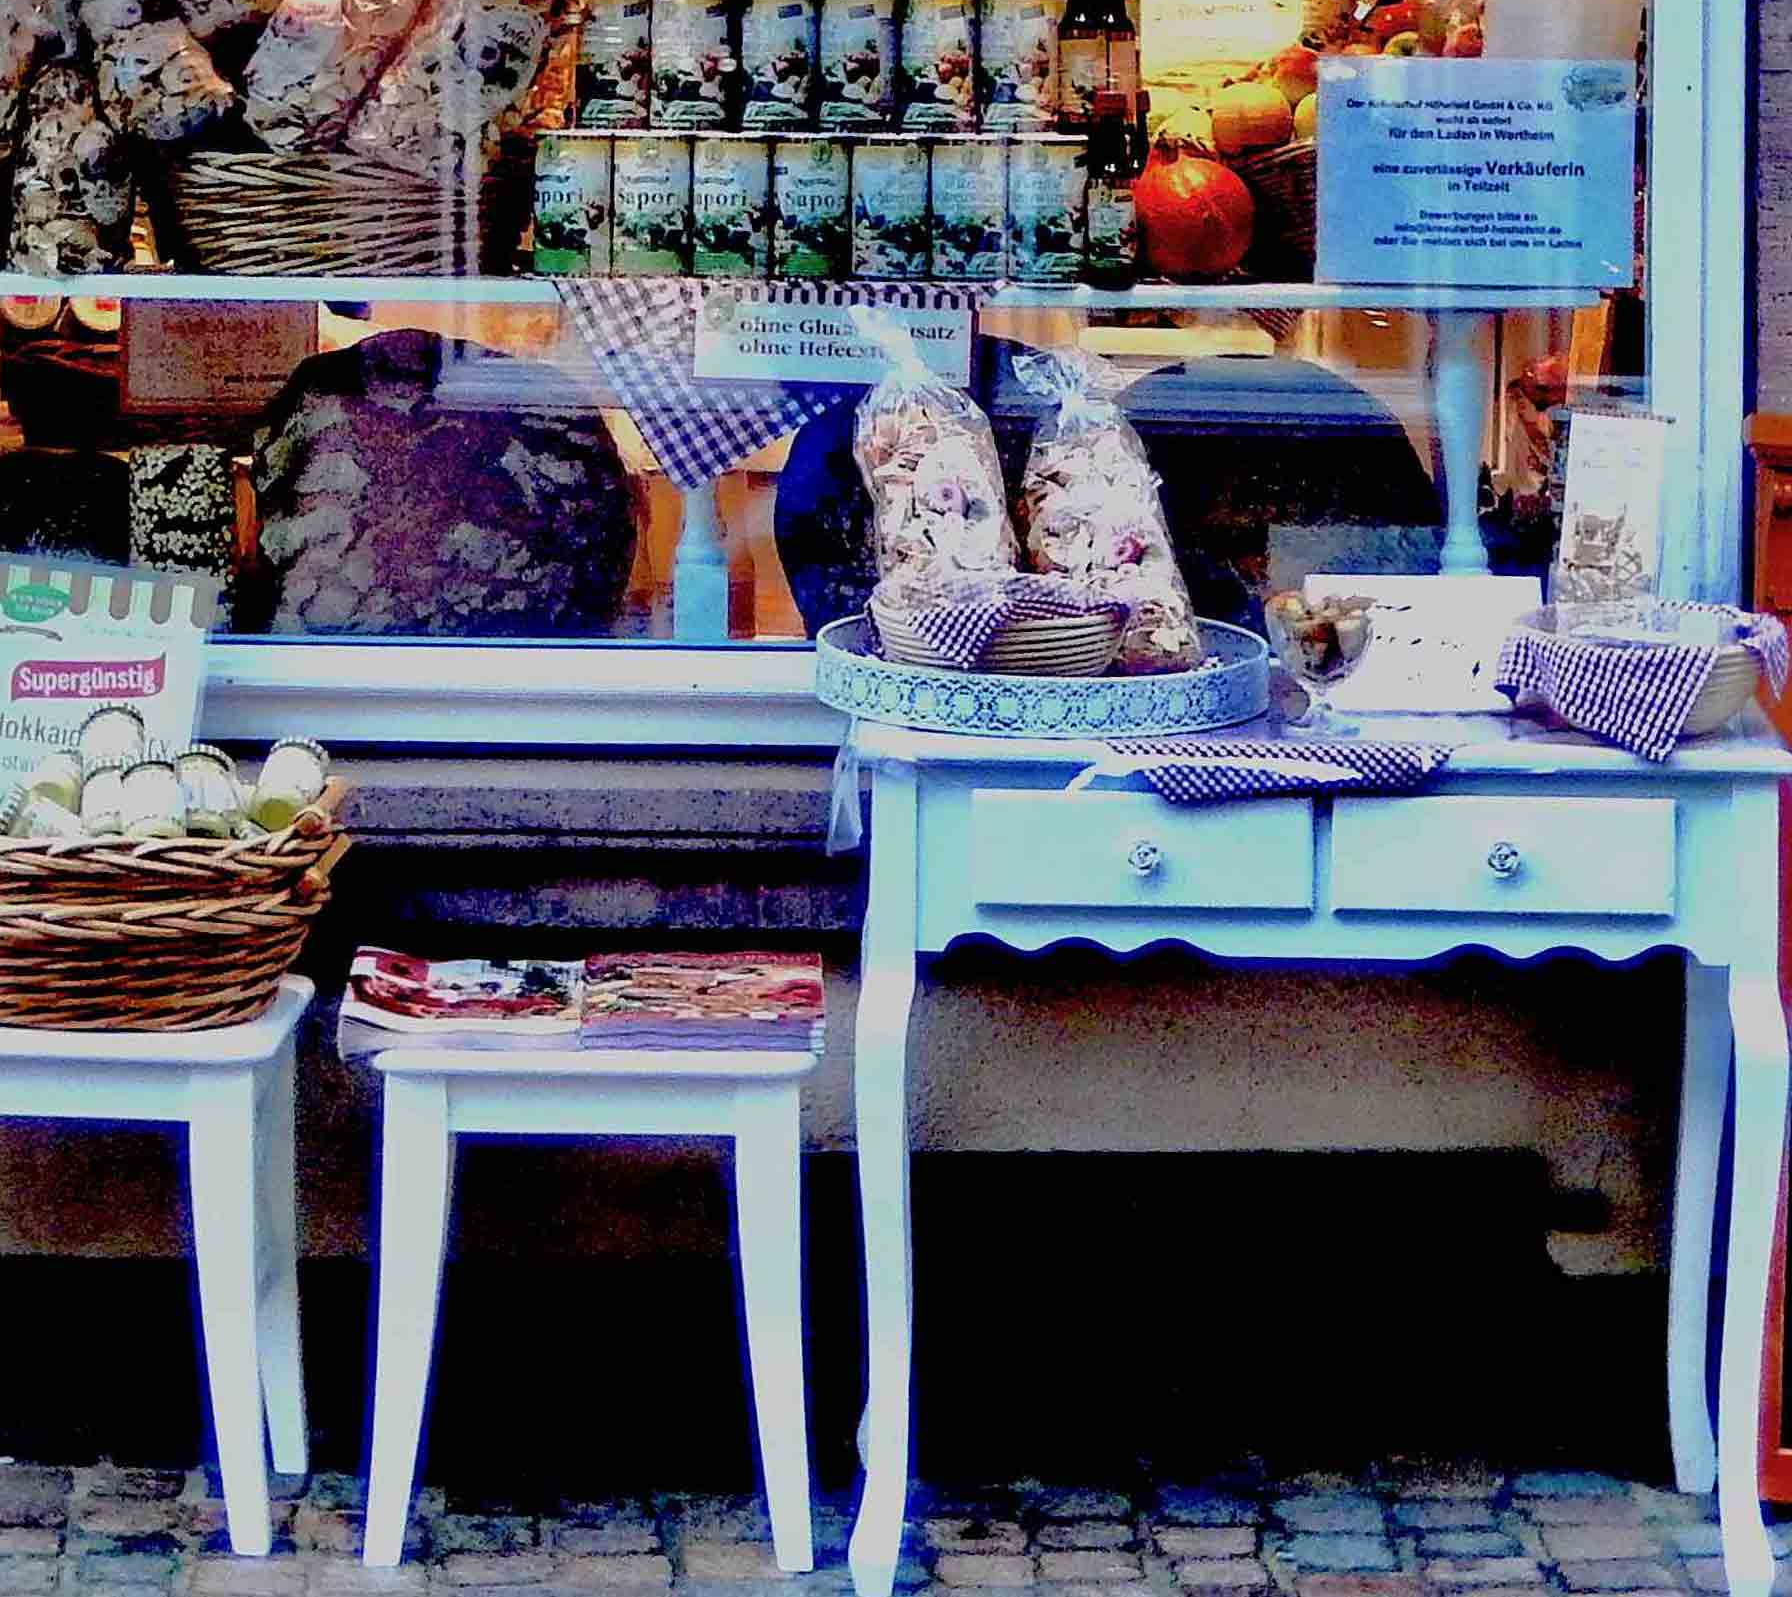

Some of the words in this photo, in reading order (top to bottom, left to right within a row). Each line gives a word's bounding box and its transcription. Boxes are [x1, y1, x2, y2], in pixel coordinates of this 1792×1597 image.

[1485, 161, 1586, 177] Verkäuferin
[739, 316, 793, 334] ohne
[739, 338, 792, 355] ohne
[18, 663, 157, 696] Supergünstig
